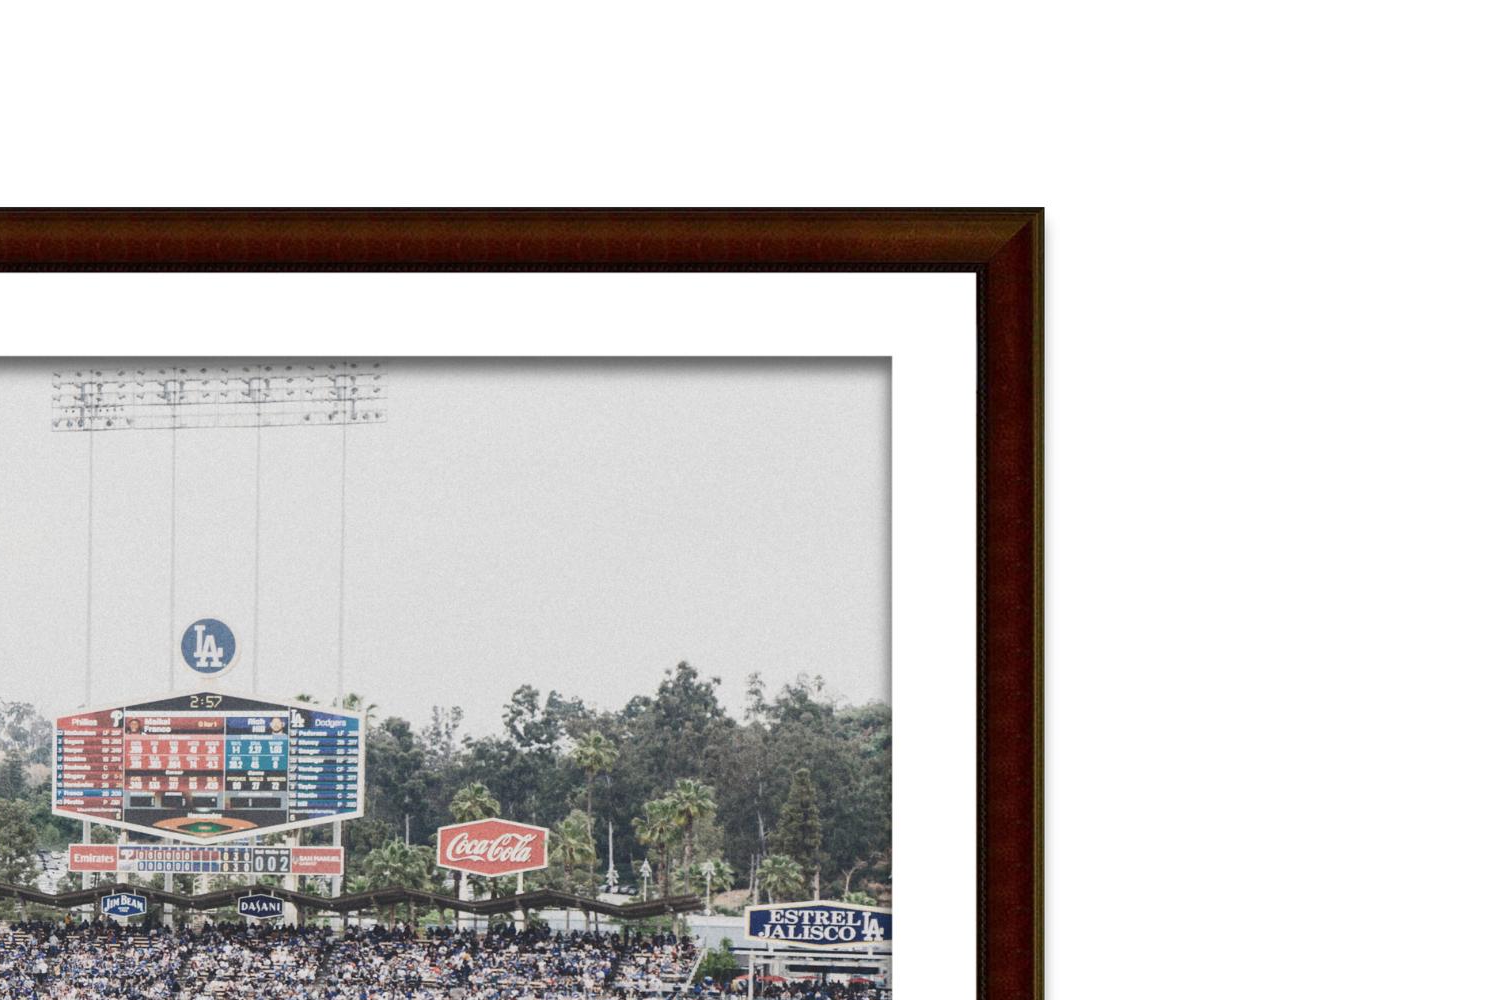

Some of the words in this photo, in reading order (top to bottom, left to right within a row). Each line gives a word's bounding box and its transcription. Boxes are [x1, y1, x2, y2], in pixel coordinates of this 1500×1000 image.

[193, 625, 225, 668] LA
[190, 695, 222, 708] 2:57
[144, 725, 172, 733] Franco
[314, 719, 347, 728] Dodgers
[446, 832, 537, 863] Coca-Cola
[73, 853, 115, 864] Emirates
[255, 856, 264, 872] 0
[267, 856, 276, 872] 0
[280, 856, 288, 872] 2
[104, 897, 120, 912] JIM
[120, 894, 144, 912] BEAM
[241, 900, 280, 912] DASANI
[758, 924, 856, 941] JALISCO
